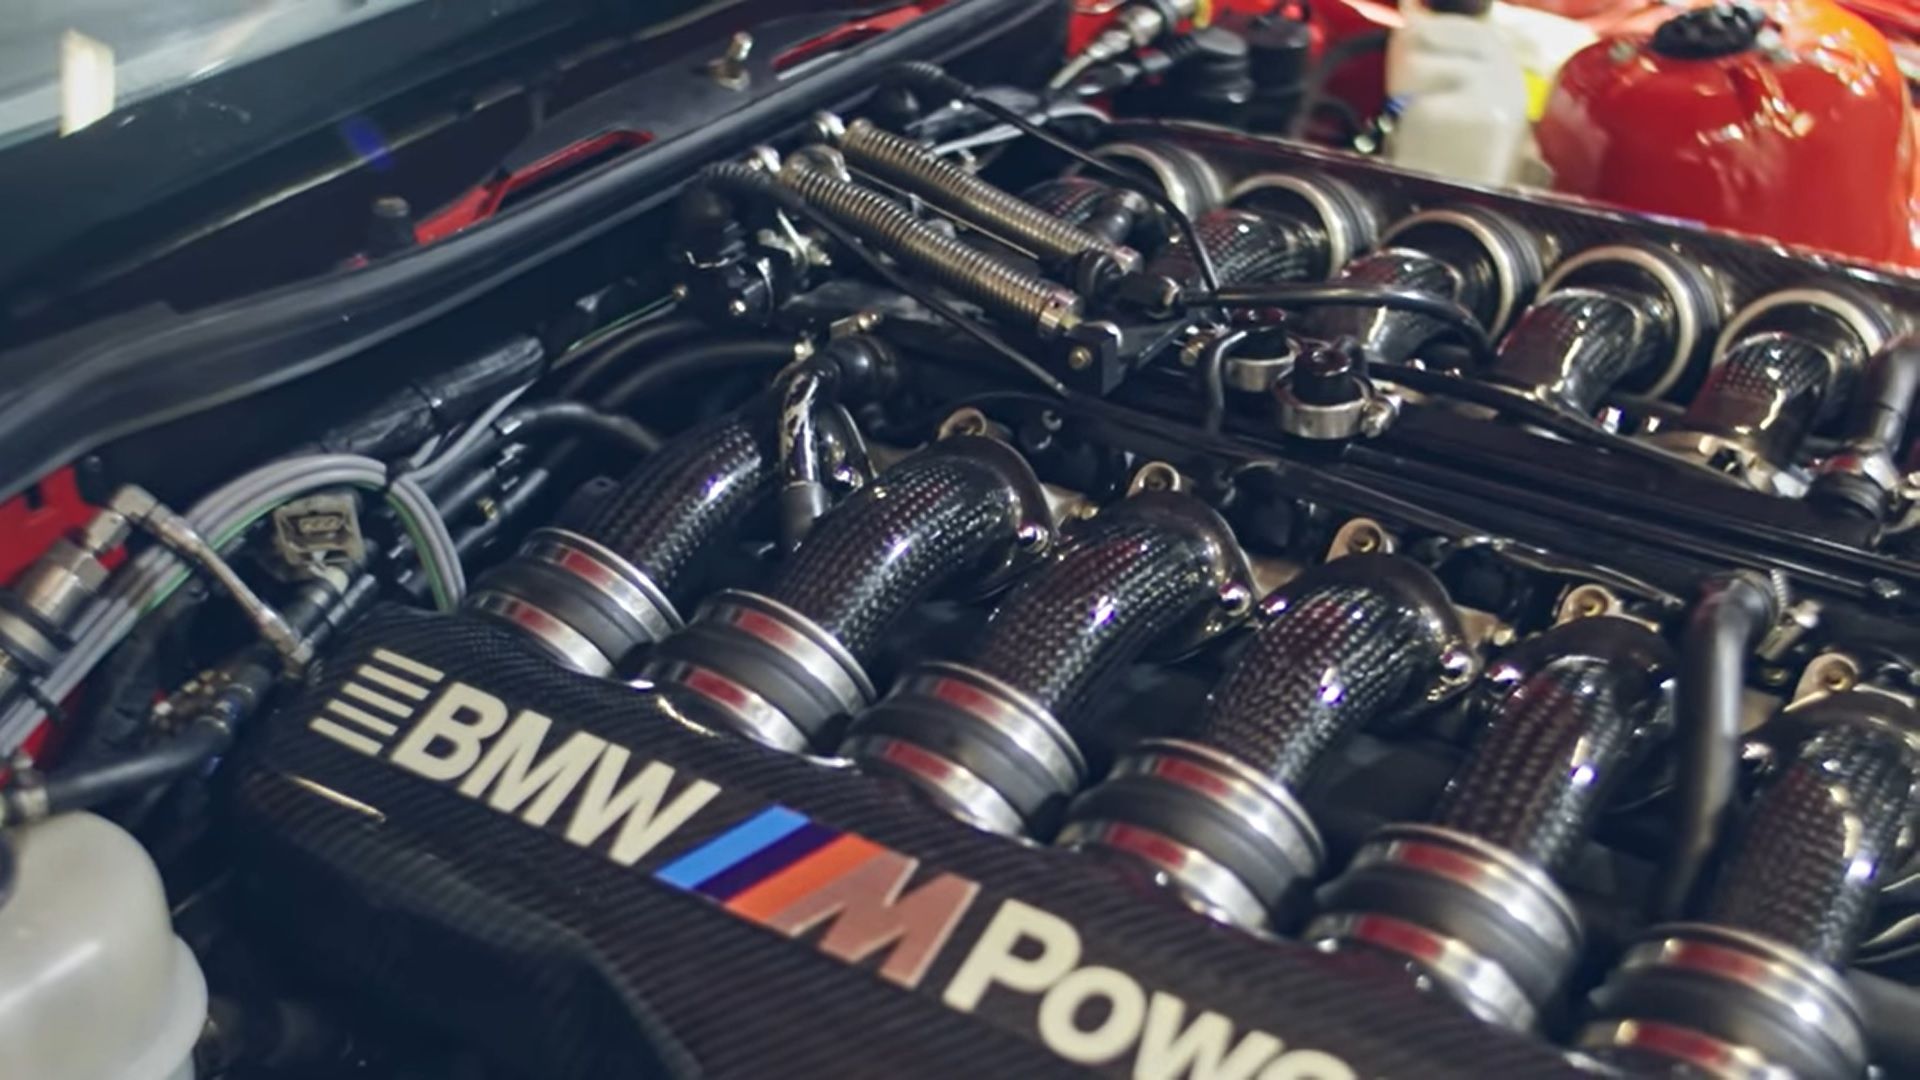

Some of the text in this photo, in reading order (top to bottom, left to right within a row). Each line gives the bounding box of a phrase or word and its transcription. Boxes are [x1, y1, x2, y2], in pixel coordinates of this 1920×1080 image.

[389, 681, 1358, 1080] BMW M Pow
